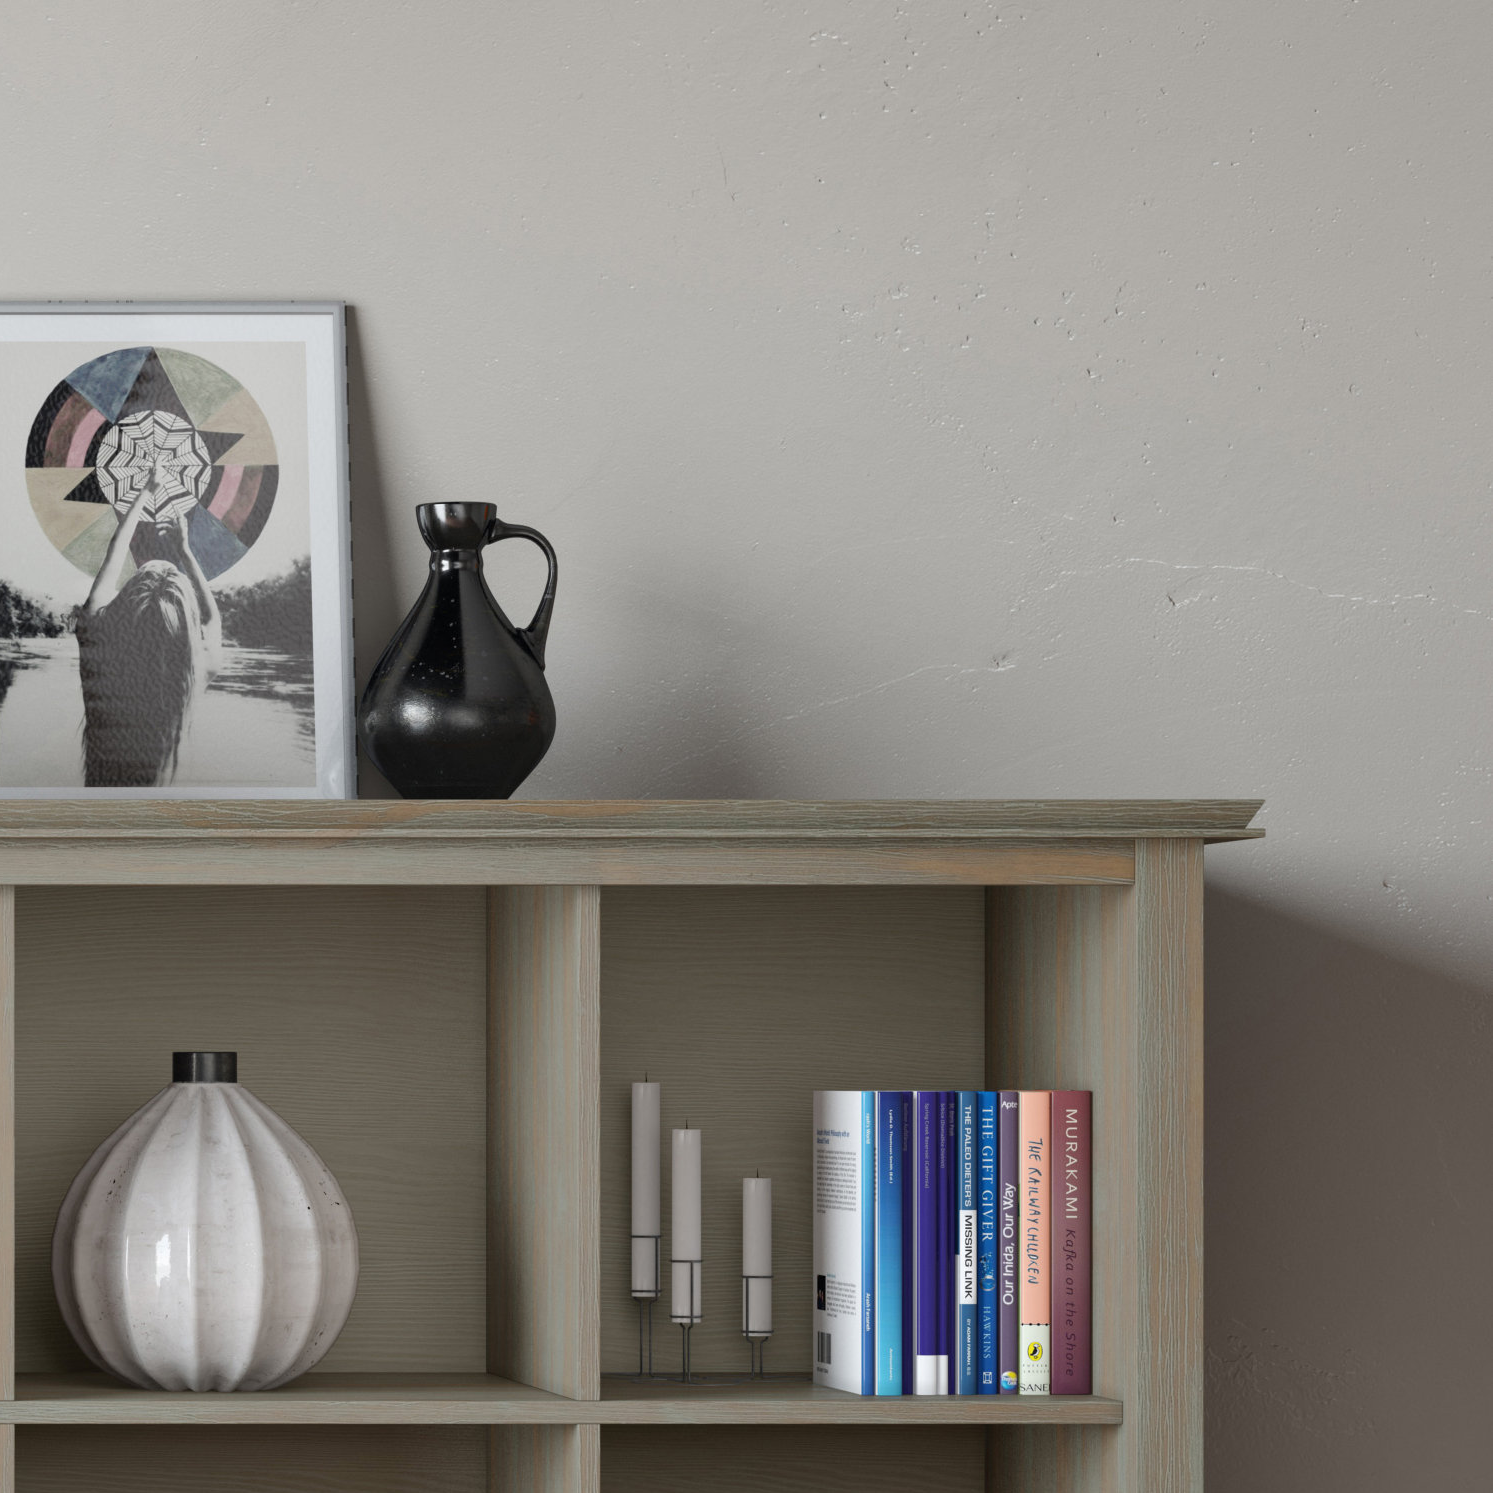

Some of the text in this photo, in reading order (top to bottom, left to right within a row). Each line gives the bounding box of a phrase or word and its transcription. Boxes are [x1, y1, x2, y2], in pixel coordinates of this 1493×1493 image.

[964, 1105, 972, 1207] THE PALEO DIETER'S
[1026, 1138, 1044, 1285] THE RAILWAY CHILDREN
[964, 1215, 973, 1299] MISSING LINK
[981, 1106, 994, 1359] THE GIFT GIVER HAWKINS
[1002, 1182, 1017, 1305] Our Inida, Our Way
[1063, 1108, 1078, 1377] MURAKAMI Kafka on the Shore
[1019, 1383, 1050, 1392] SANE
